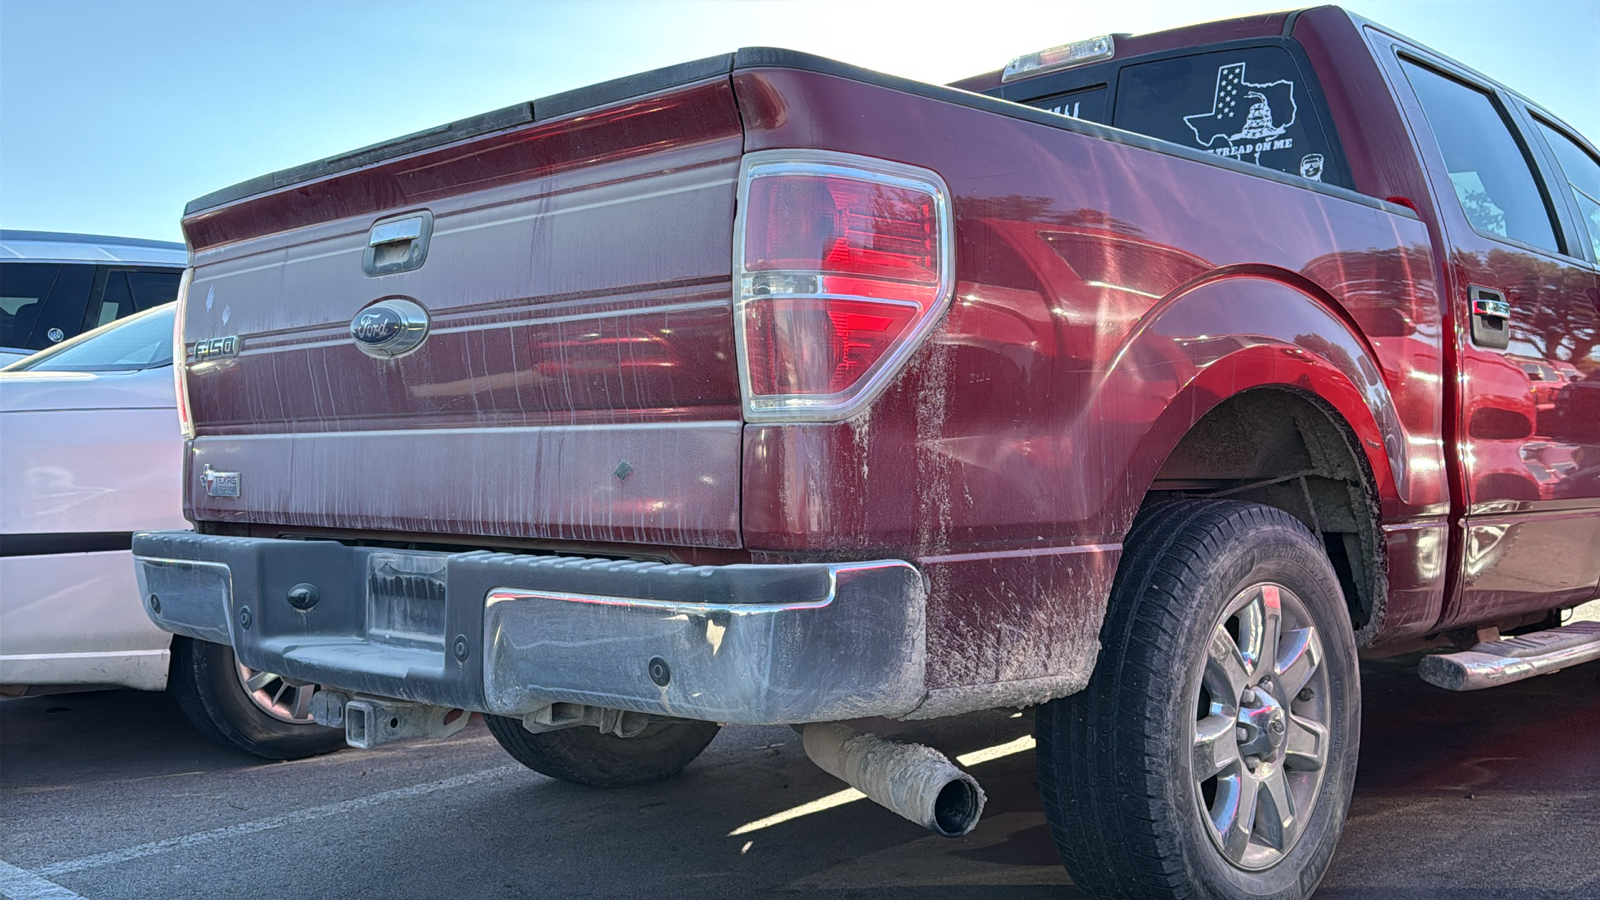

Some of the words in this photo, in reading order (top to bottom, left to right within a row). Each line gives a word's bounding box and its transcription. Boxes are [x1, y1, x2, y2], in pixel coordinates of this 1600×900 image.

[1215, 144, 1253, 157] TREAD
[1255, 141, 1271, 152] ON
[1273, 138, 1293, 150] ME
[358, 313, 388, 339] Ford
[194, 336, 237, 359] F-150
[214, 476, 237, 485] TEXAS
